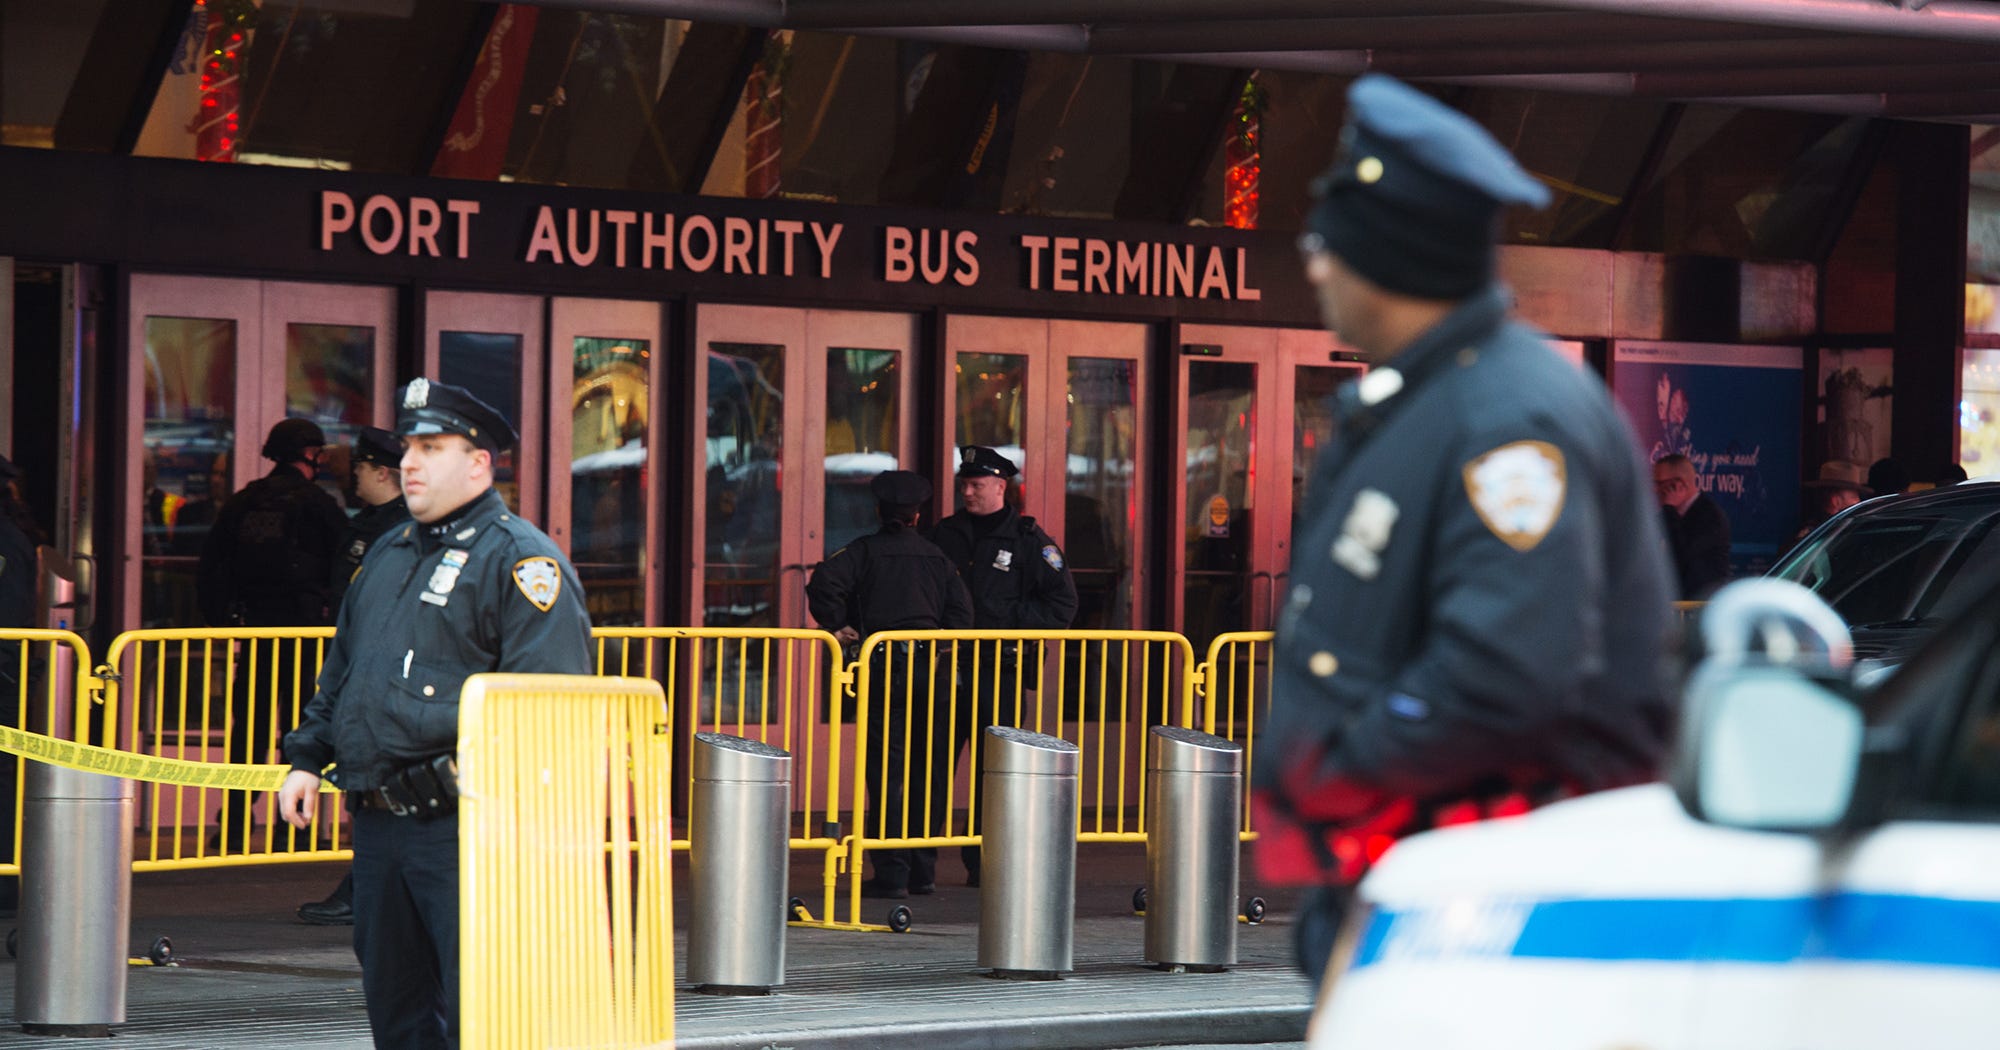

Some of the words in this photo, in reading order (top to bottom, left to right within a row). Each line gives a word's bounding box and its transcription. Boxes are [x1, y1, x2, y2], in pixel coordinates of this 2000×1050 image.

[320, 190, 480, 259] PORT
[526, 205, 844, 279] AUTHORITY
[884, 226, 981, 287] BUS
[1021, 235, 1262, 301] TERMINAL
[1649, 440, 1708, 473] Ething
[1711, 452, 1731, 472] you
[1695, 474, 1716, 492] our
[1717, 474, 1745, 499] way.
